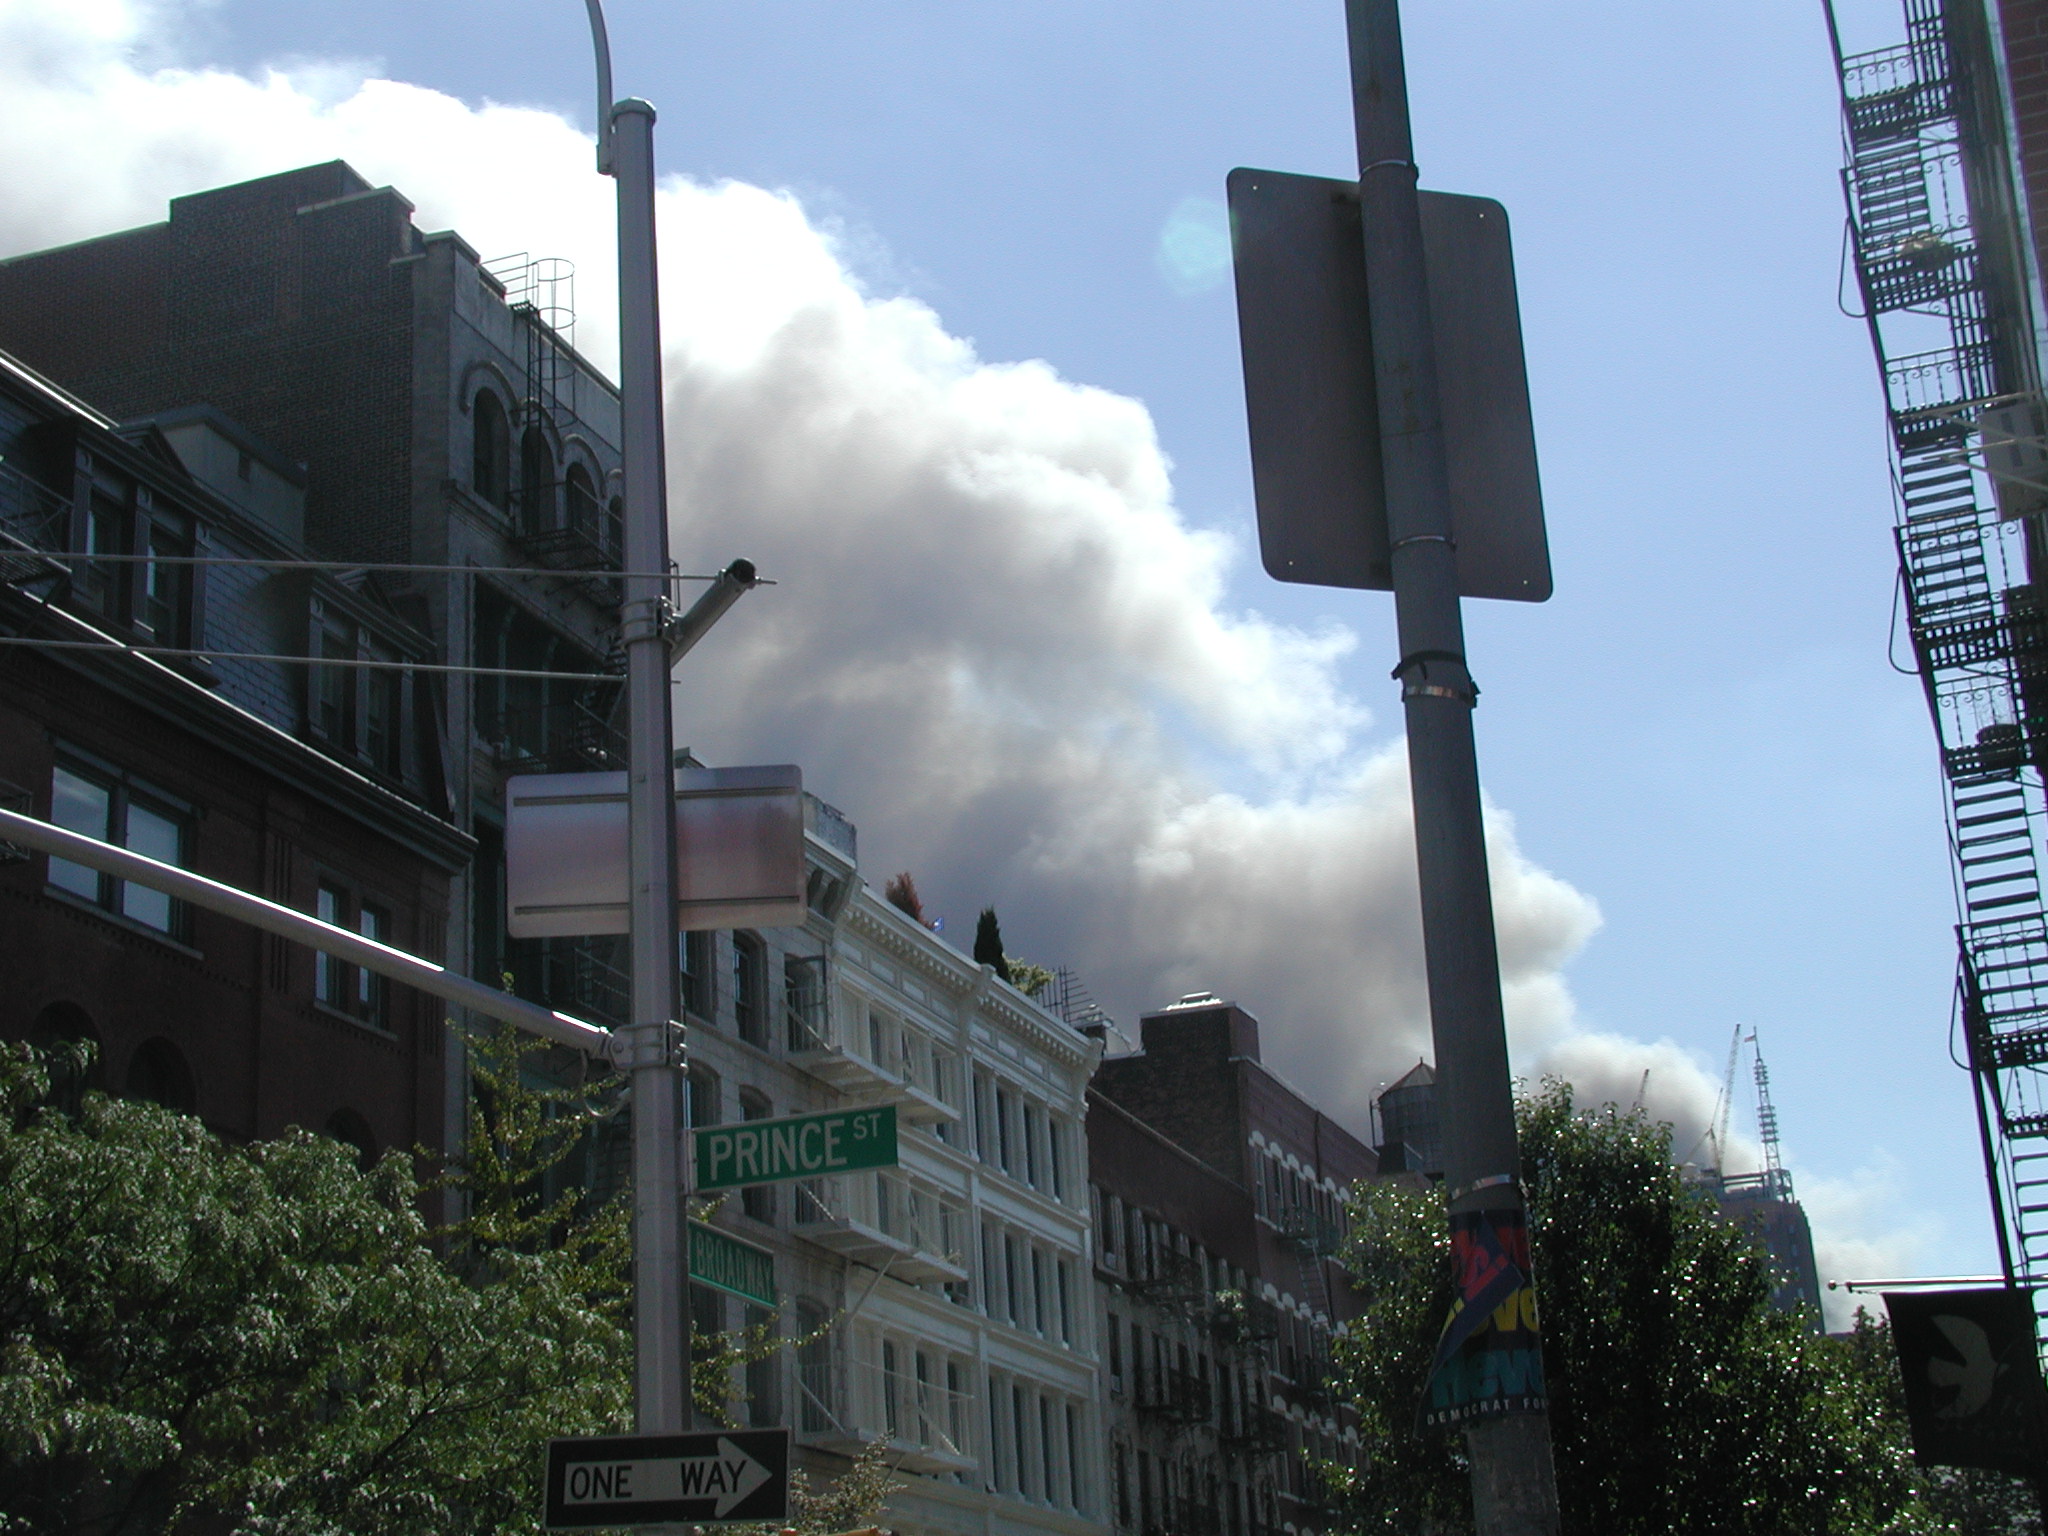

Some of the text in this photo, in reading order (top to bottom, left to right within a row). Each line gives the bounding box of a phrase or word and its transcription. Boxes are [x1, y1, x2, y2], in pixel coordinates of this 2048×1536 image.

[709, 1113, 881, 1182] PRINCE ST
[696, 1231, 774, 1301] BROADWAY
[1426, 1398, 1510, 1426] DEMOCRAT
[570, 1459, 747, 1499] ONE WAY
